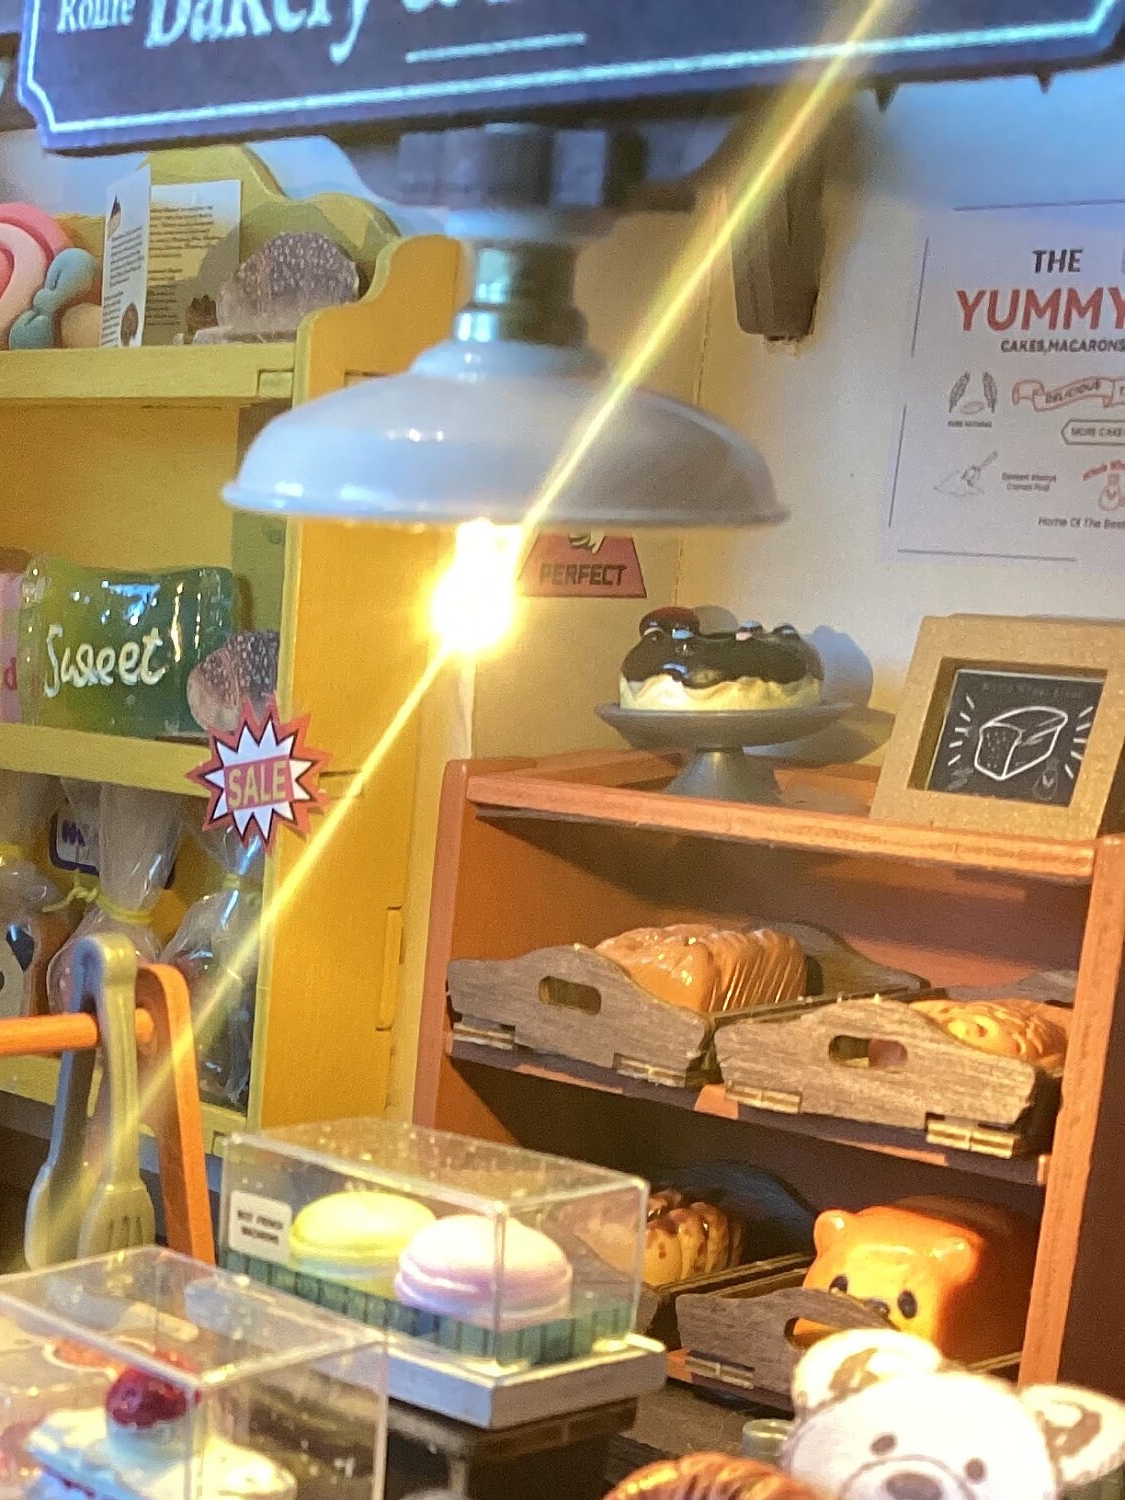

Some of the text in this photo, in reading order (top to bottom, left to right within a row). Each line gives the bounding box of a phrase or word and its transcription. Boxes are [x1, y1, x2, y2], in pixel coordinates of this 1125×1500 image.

[1032, 248, 1084, 273] THE
[956, 287, 1125, 332] YUMMY
[539, 562, 628, 587] PERFECT
[44, 623, 170, 698] Sweet
[227, 761, 287, 809] SALE
